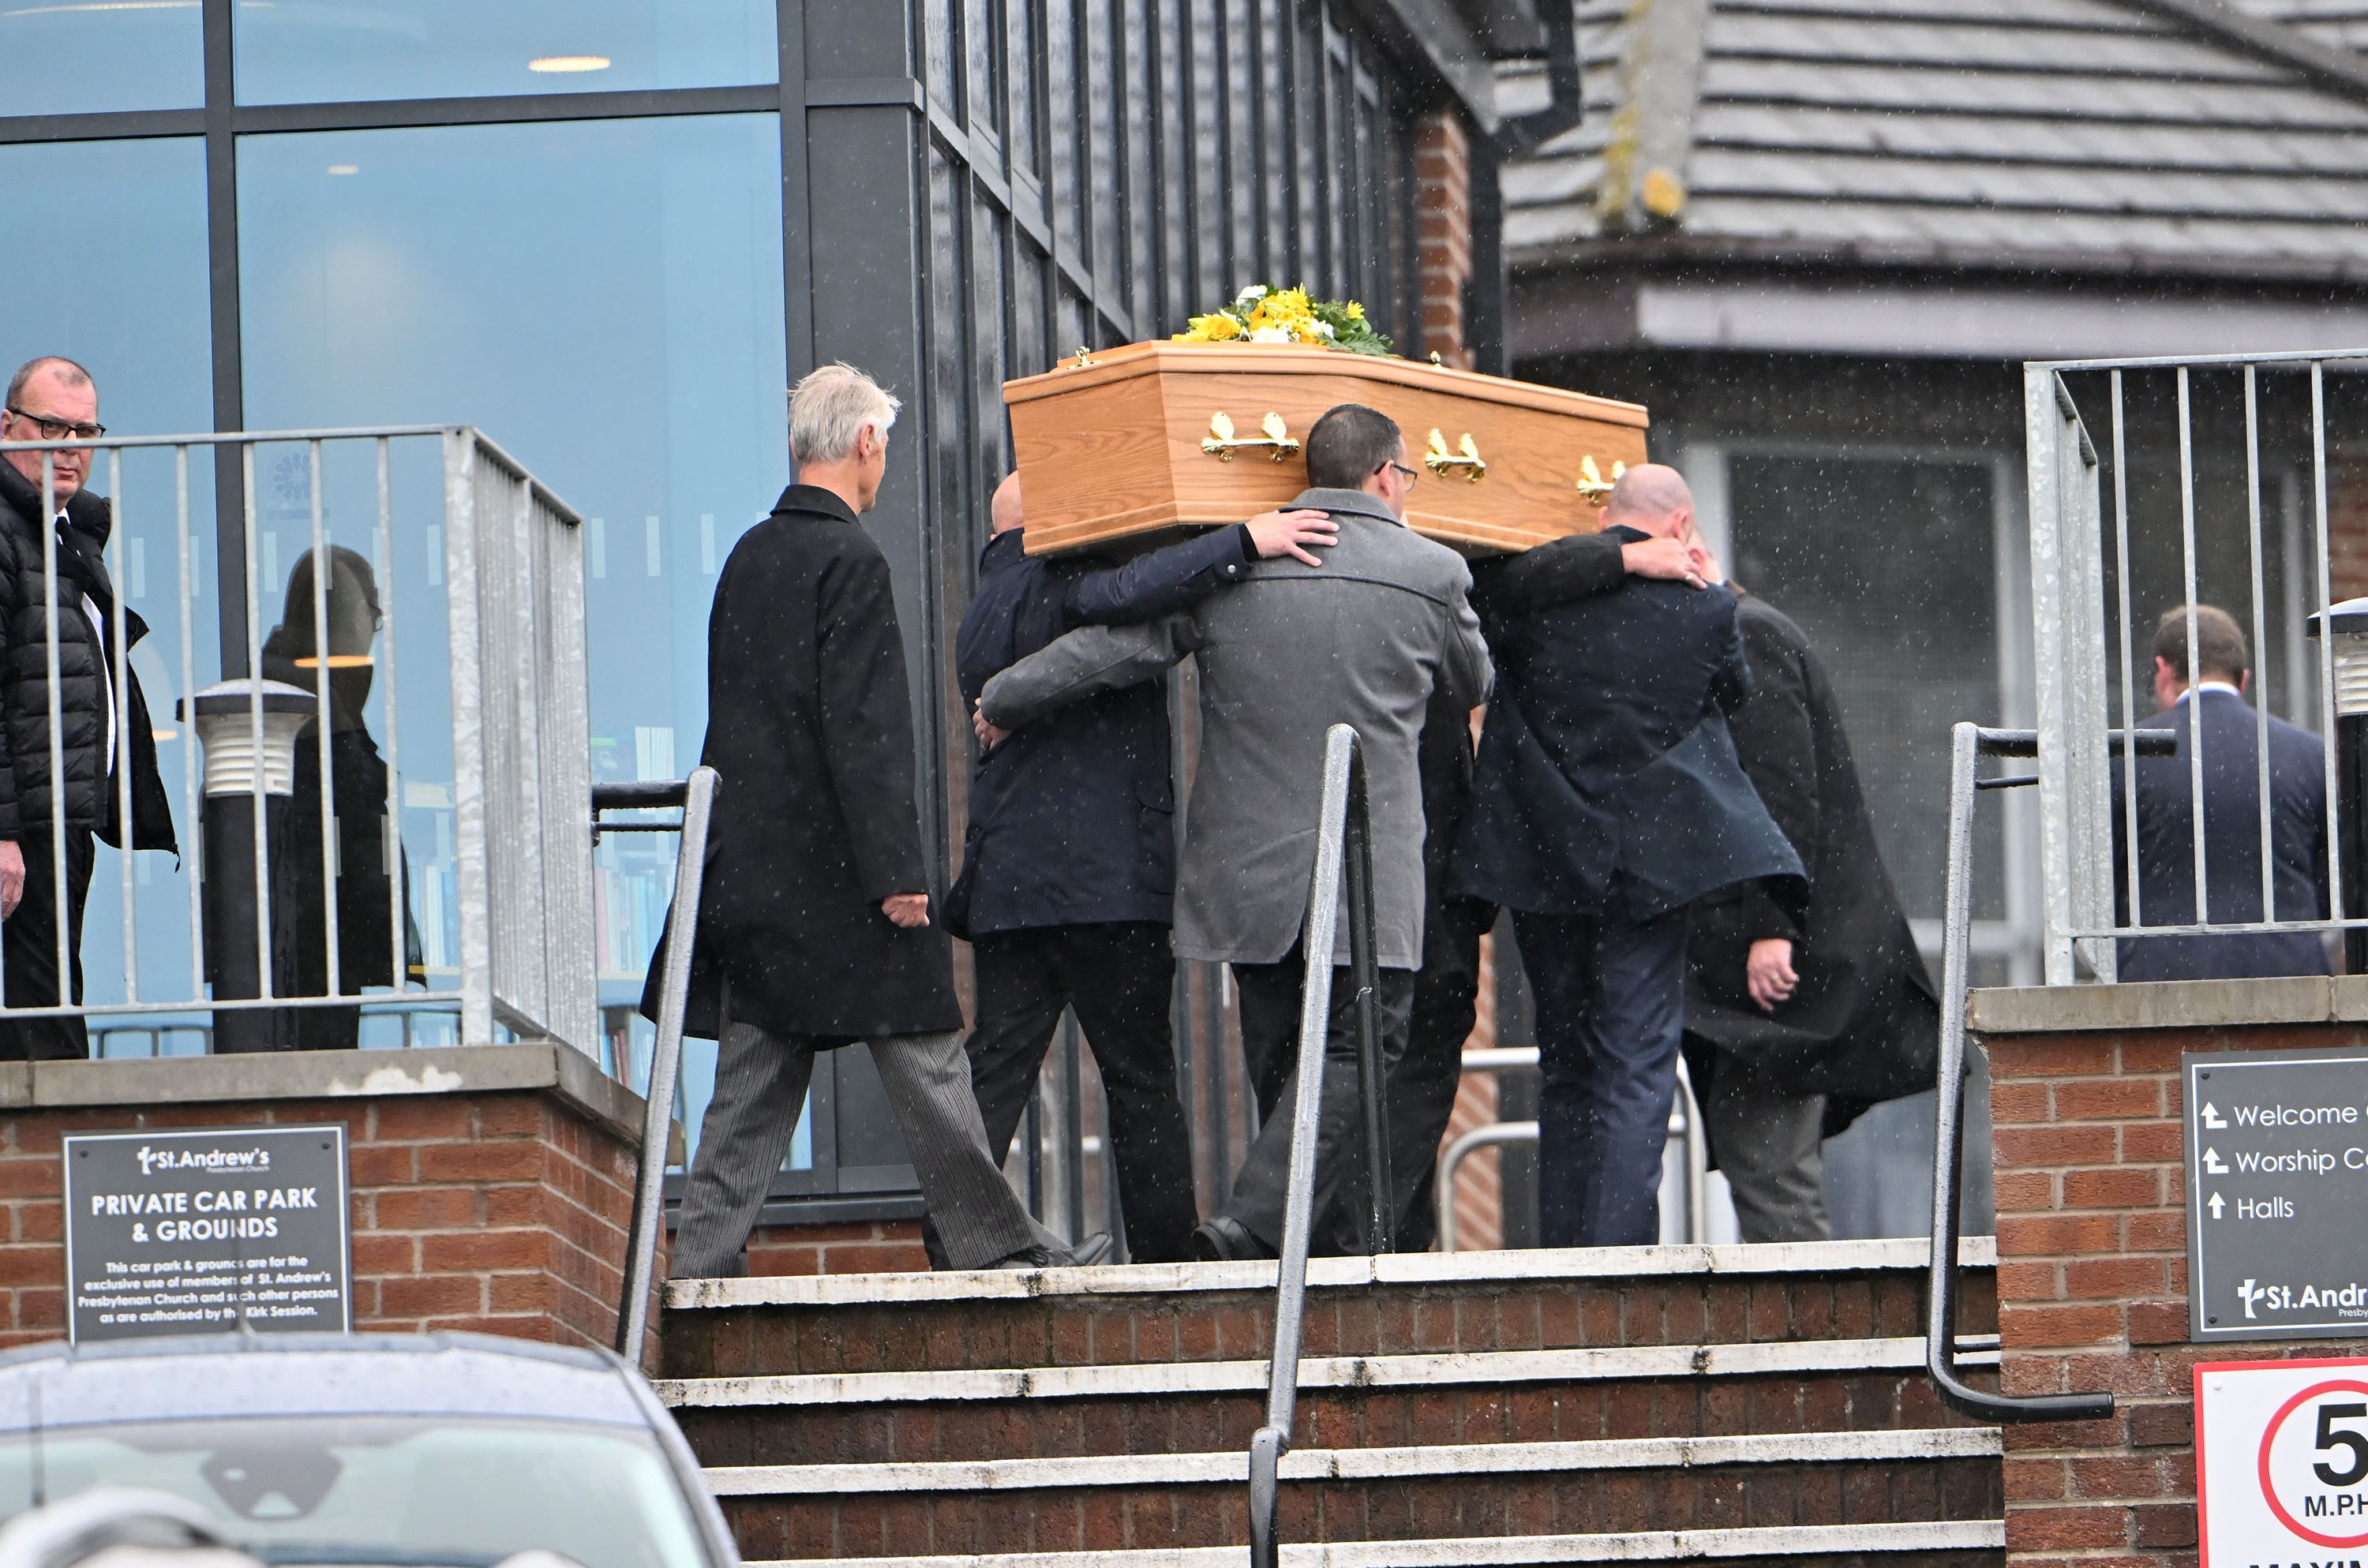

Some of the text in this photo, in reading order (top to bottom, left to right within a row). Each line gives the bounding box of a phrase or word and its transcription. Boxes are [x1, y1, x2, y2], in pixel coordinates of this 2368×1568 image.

[2234, 1104, 2359, 1127] Welcome
[156, 1147, 270, 1169] St.Andrew's
[2235, 1147, 2368, 1175] Worship C
[91, 1187, 317, 1215] PRIVATE CAR PARK
[2237, 1196, 2295, 1220] Halls
[132, 1216, 278, 1243] & GROUNDS
[105, 1262, 129, 1274] This
[129, 1263, 152, 1273] car
[153, 1260, 182, 1274] park
[183, 1259, 193, 1271] &
[245, 1258, 268, 1269] are
[268, 1256, 286, 1267] for
[287, 1256, 309, 1267] the
[84, 1270, 332, 1291] exclusive use of members of St. Andrew's
[77, 1295, 152, 1308] Presbyterian
[154, 1292, 198, 1304] Church
[200, 1291, 225, 1303] and
[257, 1289, 290, 1301] other
[291, 1289, 339, 1302] persons
[2266, 1283, 2368, 1310] St.Andr
[99, 1304, 318, 1323] as are authorised by th Kirk Session.
[2312, 1402, 2368, 1488] 5
